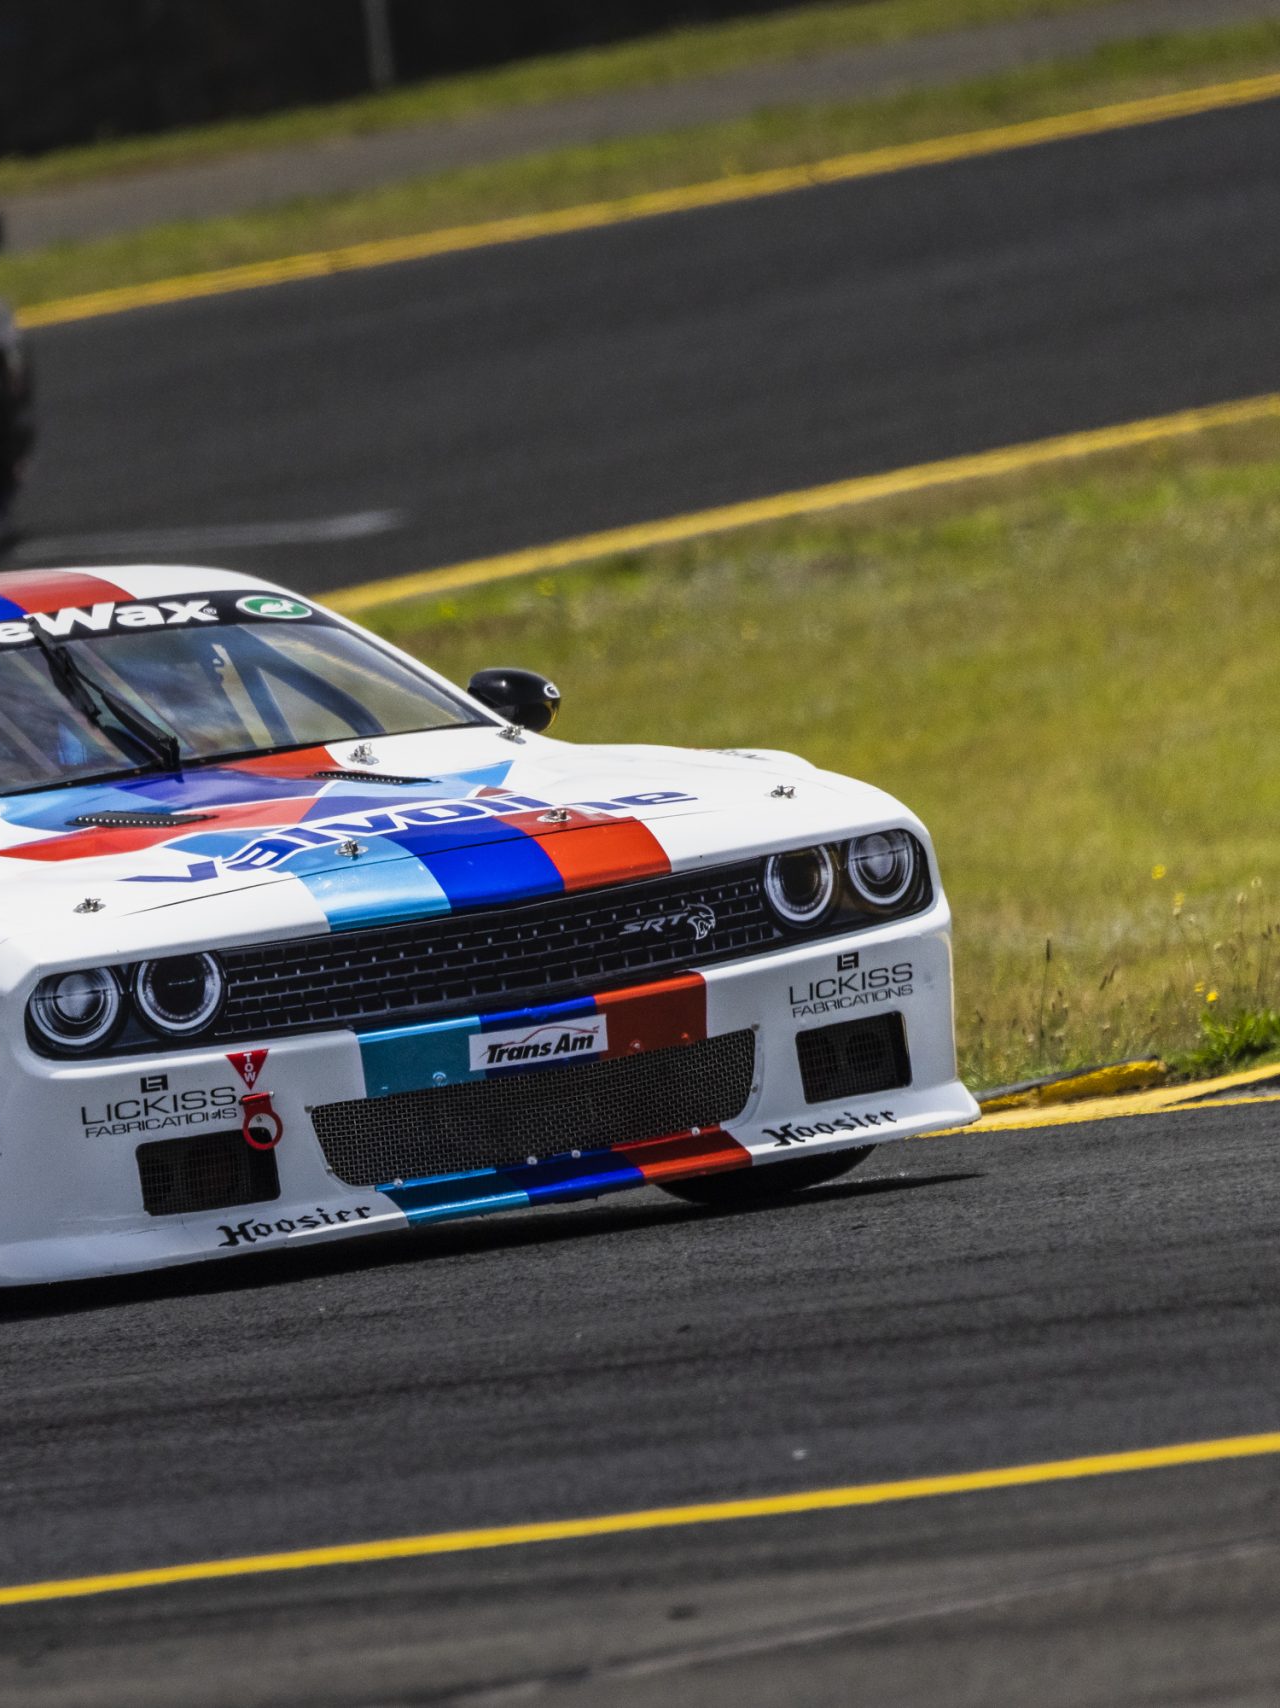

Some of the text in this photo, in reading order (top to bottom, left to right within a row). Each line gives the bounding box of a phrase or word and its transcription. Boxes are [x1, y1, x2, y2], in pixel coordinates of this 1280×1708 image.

[621, 912, 688, 934] SRT
[789, 963, 913, 1006] LICKISS
[792, 984, 914, 1018] FABRICATIONS
[243, 1052, 258, 1083] TOW
[81, 1086, 238, 1126] LICKISS
[85, 1107, 238, 1139] FABRICATIONS
[761, 1110, 897, 1147] Hoosier
[217, 1206, 371, 1248] Hoosier
